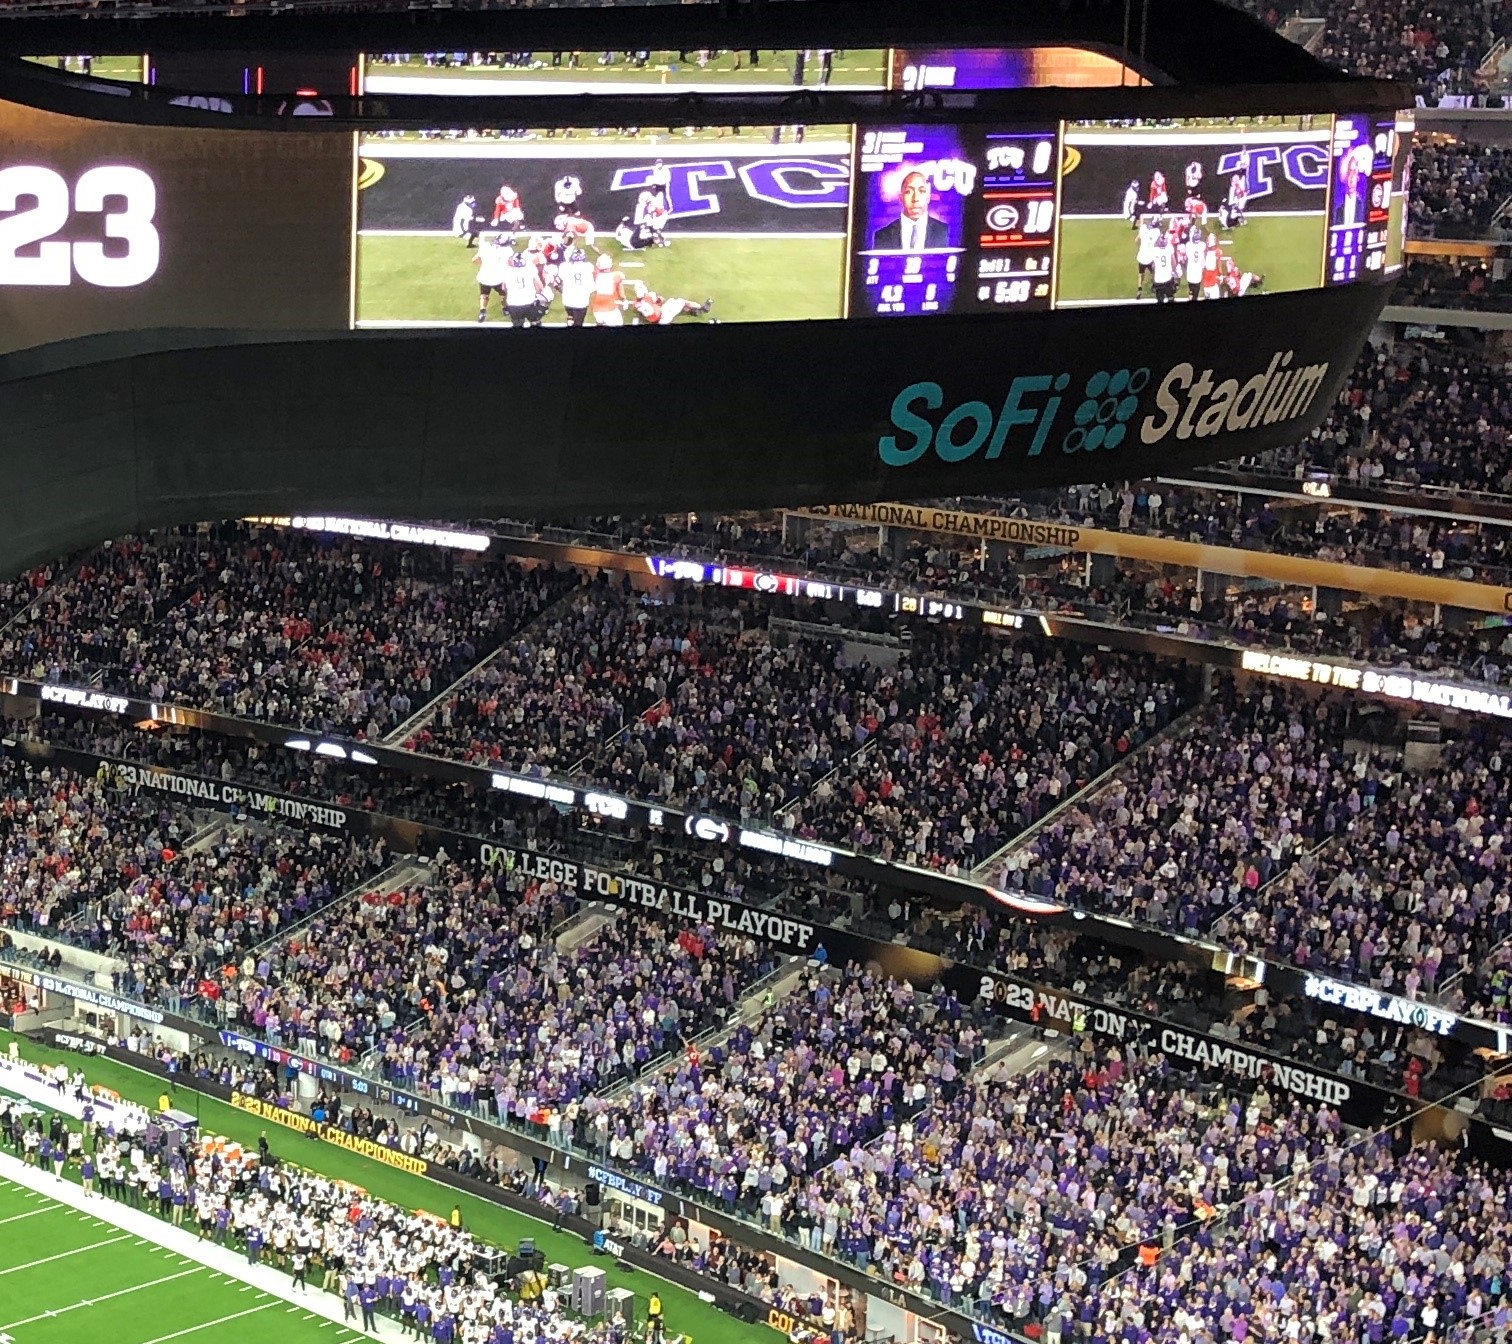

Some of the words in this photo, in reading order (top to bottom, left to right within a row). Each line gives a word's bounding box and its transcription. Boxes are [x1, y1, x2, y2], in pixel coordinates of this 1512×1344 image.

[878, 372, 1070, 467] SoFi
[1141, 350, 1329, 444] Stadium
[834, 505, 927, 528] NATIONAL
[932, 512, 1080, 547] CHAMPIONSHIP
[1312, 662, 1331, 683] TO
[139, 771, 219, 802] NATIONAL
[707, 900, 814, 949] PLAYOFF
[55, 981, 99, 1003] NATIONAL
[99, 994, 164, 1024] CHAMPIONSHIP
[1305, 976, 1456, 1035] #CFBPLAYOFF
[352, 1078, 368, 1094] 5:03
[263, 1103, 325, 1139] NATIONAL
[327, 1126, 427, 1175] CHAMPIONSHIP
[604, 1238, 625, 1257] AT&T
